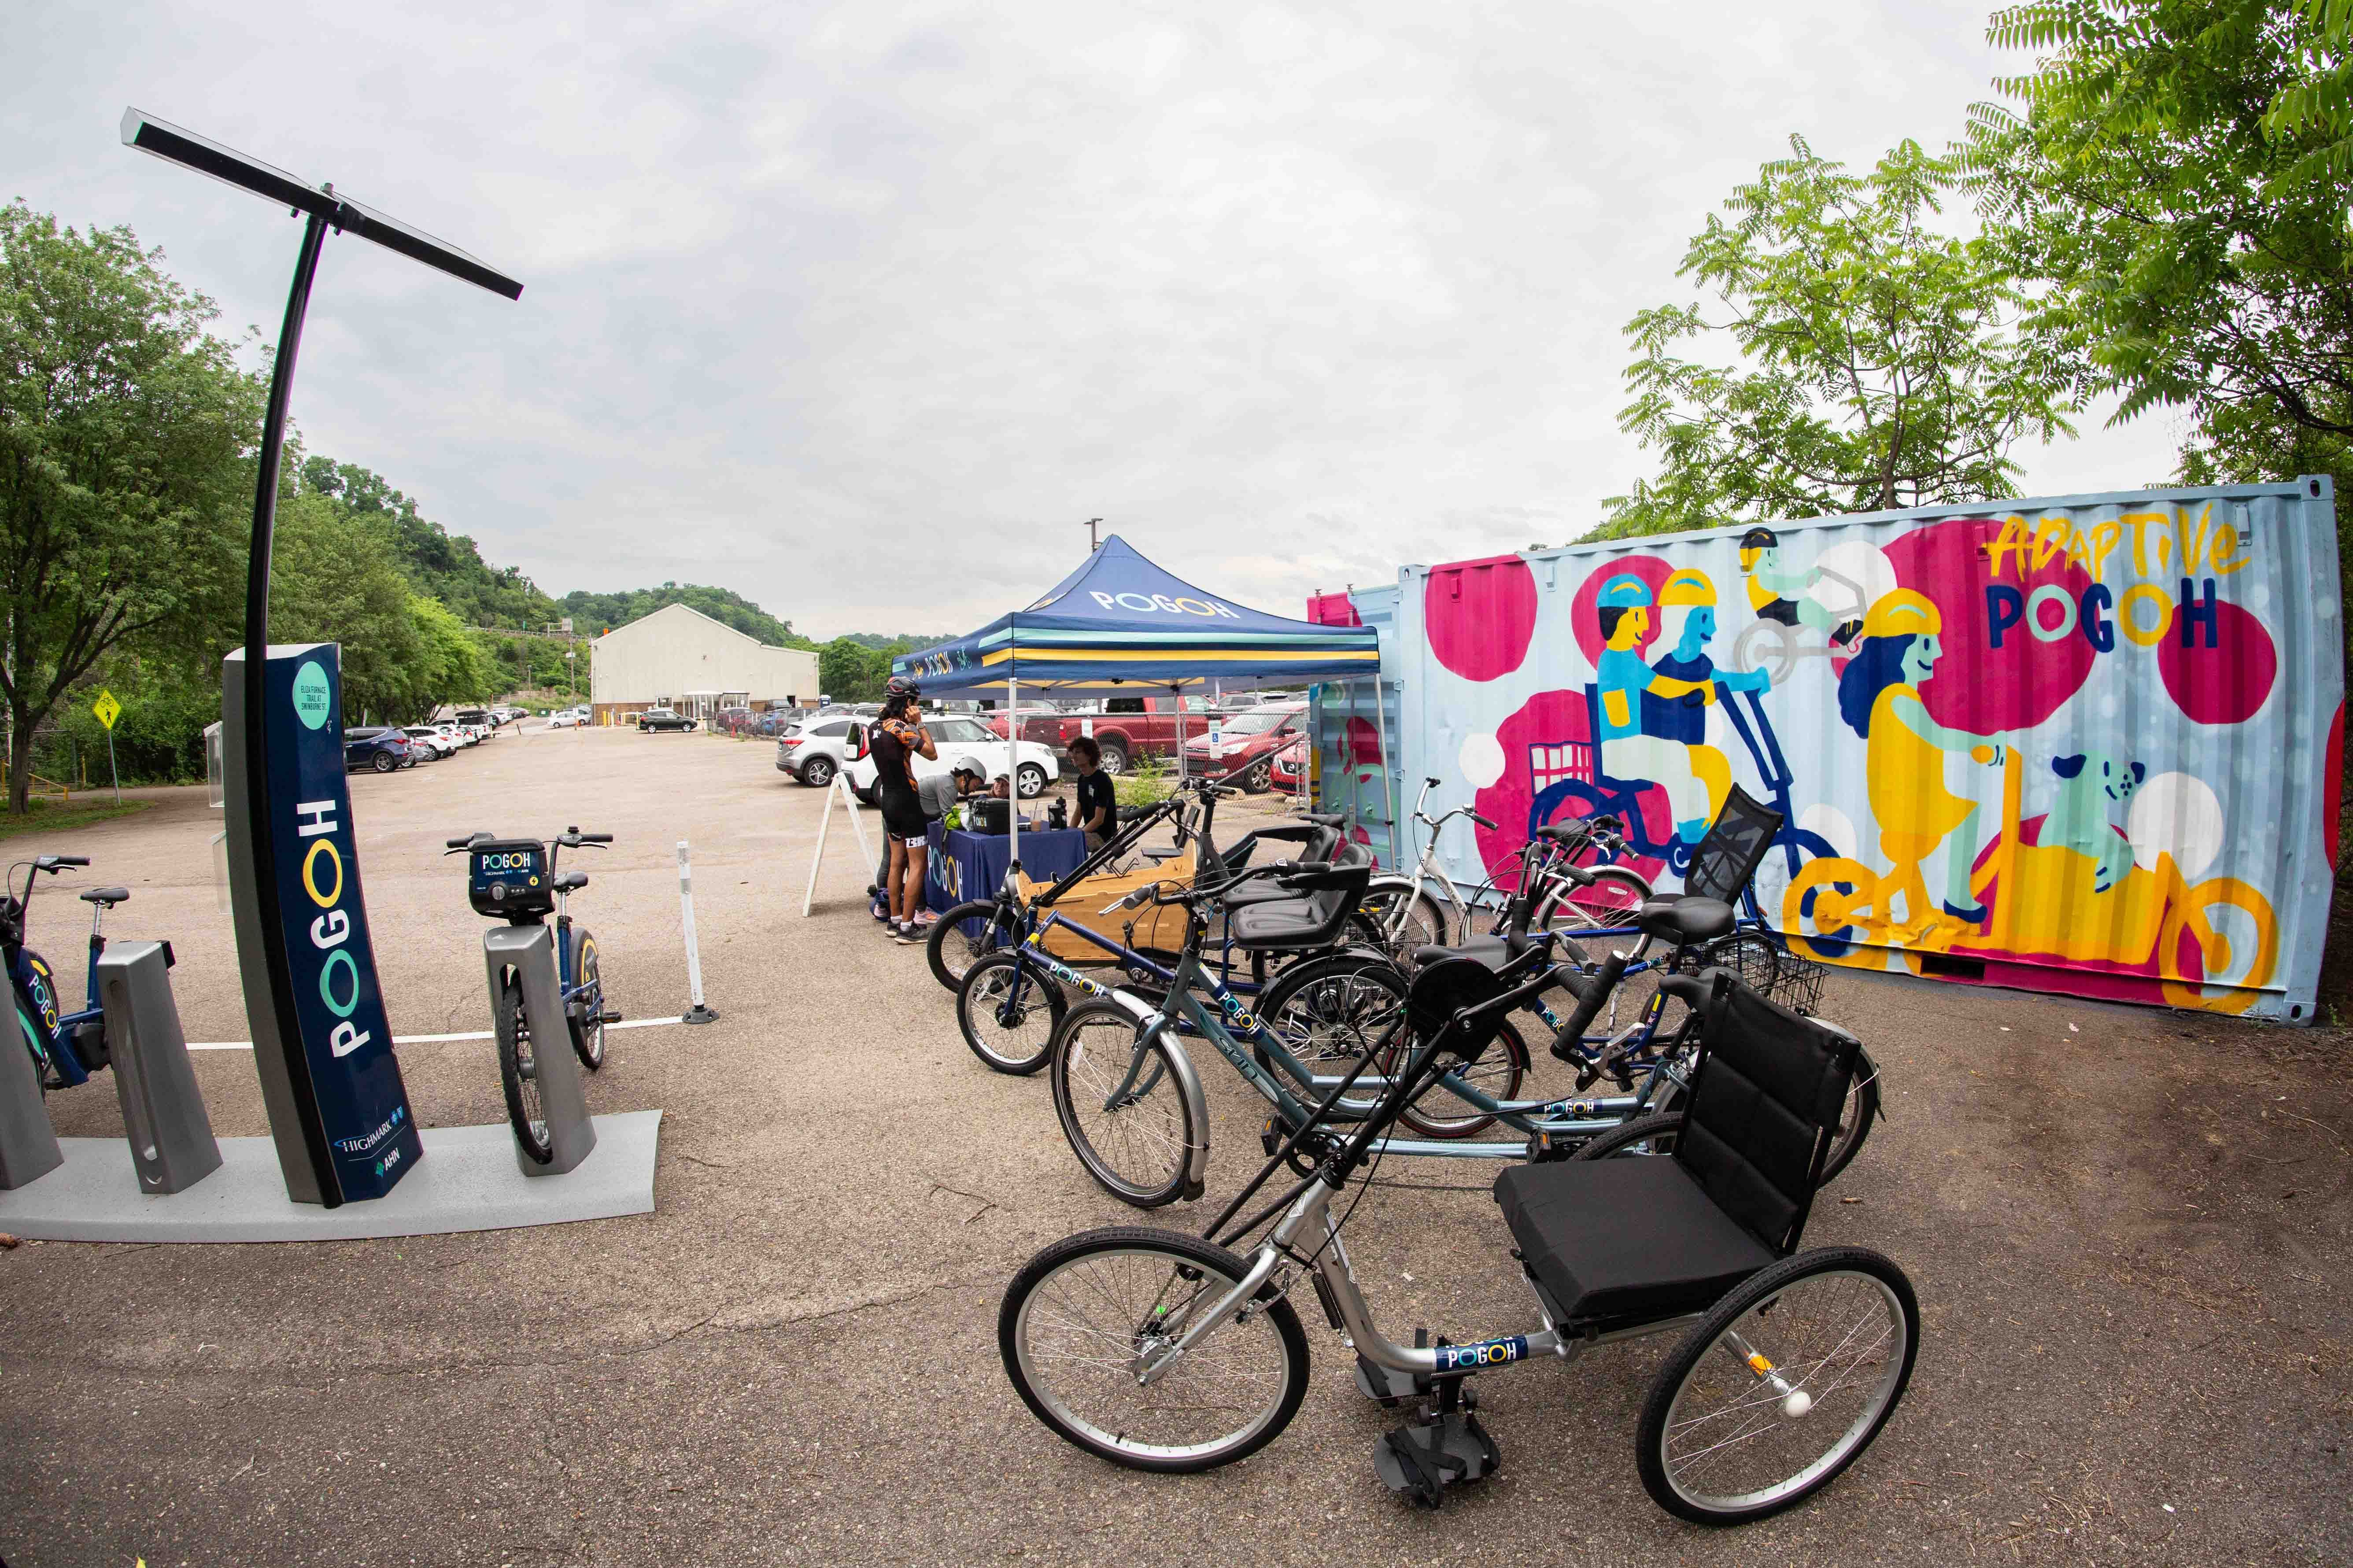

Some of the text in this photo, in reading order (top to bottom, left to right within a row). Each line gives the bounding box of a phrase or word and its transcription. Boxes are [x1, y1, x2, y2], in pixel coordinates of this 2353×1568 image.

[1089, 591, 1240, 618] POGOH
[1986, 577, 2218, 653] POGOH
[925, 651, 953, 678] POGOH
[483, 852, 530, 870] POGOH
[927, 845, 963, 903] POGOH
[296, 800, 370, 1057] POGOH
[1049, 961, 1107, 996] POGOH
[29, 974, 62, 1040] POGOH
[1218, 991, 1260, 1035] POGOH
[1544, 1101, 1594, 1114] POGOH
[343, 1119, 392, 1152] HIGHMARK
[384, 1147, 400, 1171] AHN
[1448, 1342, 1516, 1368] POGOH
